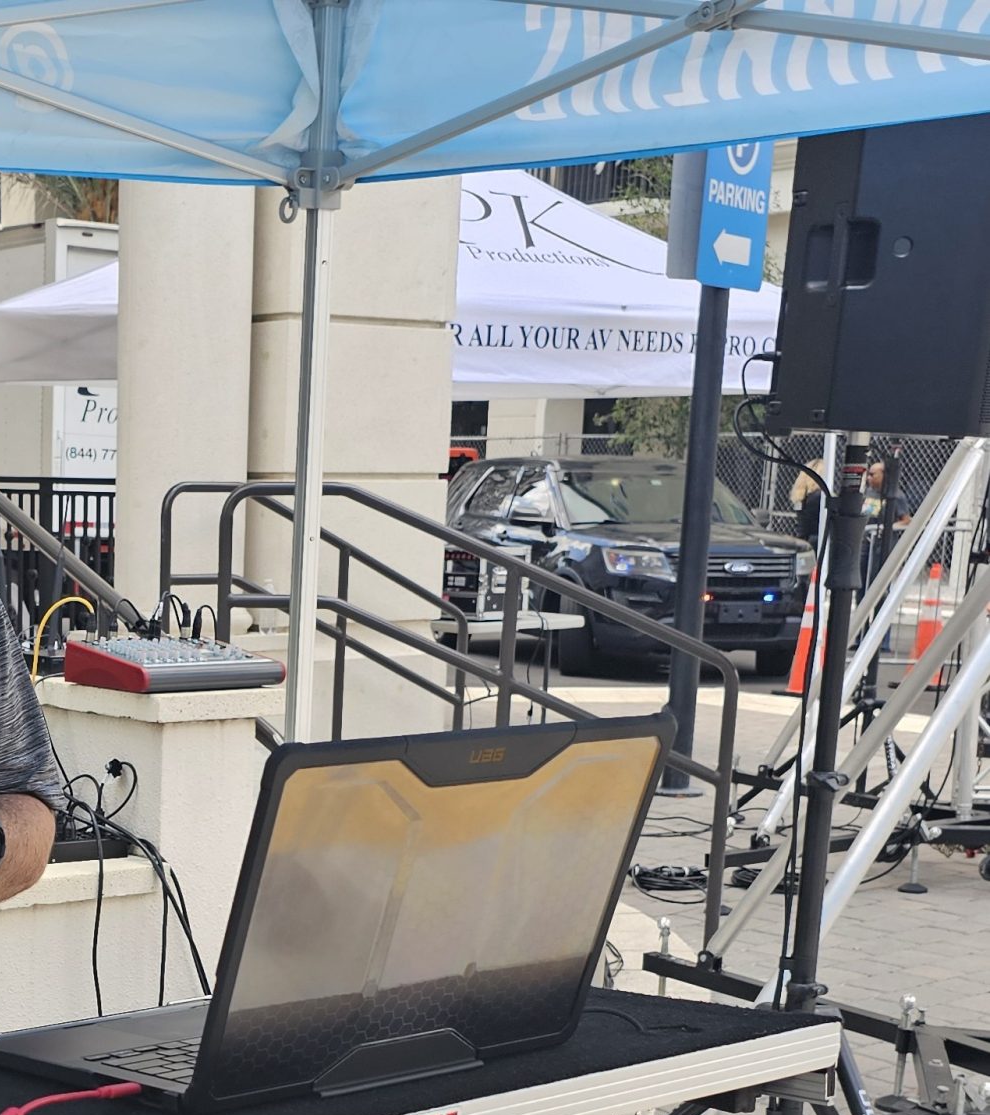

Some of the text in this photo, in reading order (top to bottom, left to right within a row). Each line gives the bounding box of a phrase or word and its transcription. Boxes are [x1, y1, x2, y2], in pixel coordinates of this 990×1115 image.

[709, 178, 766, 214] PARKING
[466, 245, 610, 268] Productions
[469, 324, 514, 348] ALL
[519, 325, 580, 350] YOUR
[584, 328, 613, 351] AV
[617, 329, 683, 353] NEEDS
[66, 446, 97, 463] (844)
